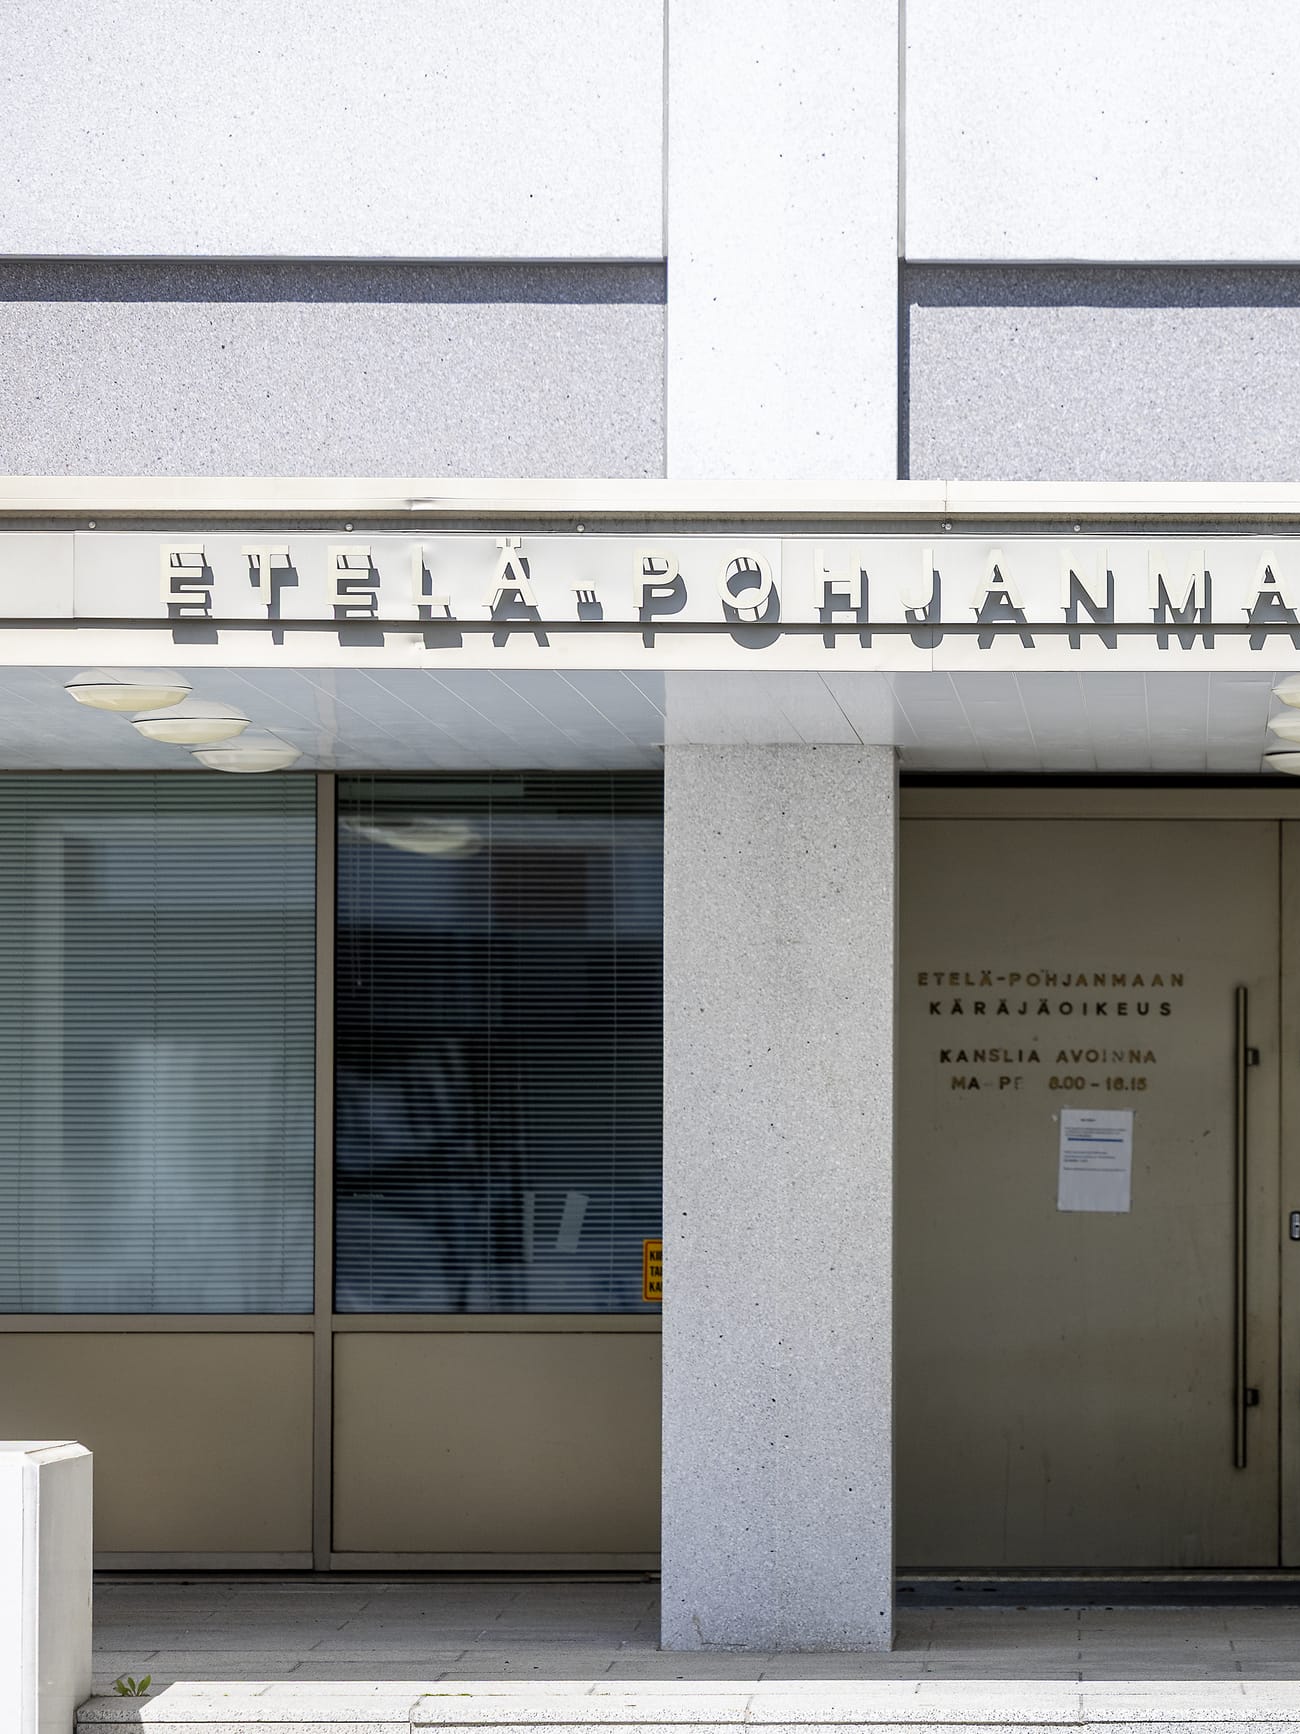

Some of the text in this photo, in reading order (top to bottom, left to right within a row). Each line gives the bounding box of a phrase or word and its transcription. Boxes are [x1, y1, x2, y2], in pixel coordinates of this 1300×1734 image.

[918, 970, 1185, 987] ETELÄ-POHJANMAAN
[929, 999, 1172, 1016] KÄRÄJÄOIKEUS
[940, 1050, 1157, 1063] KANSLIA AVOINNA
